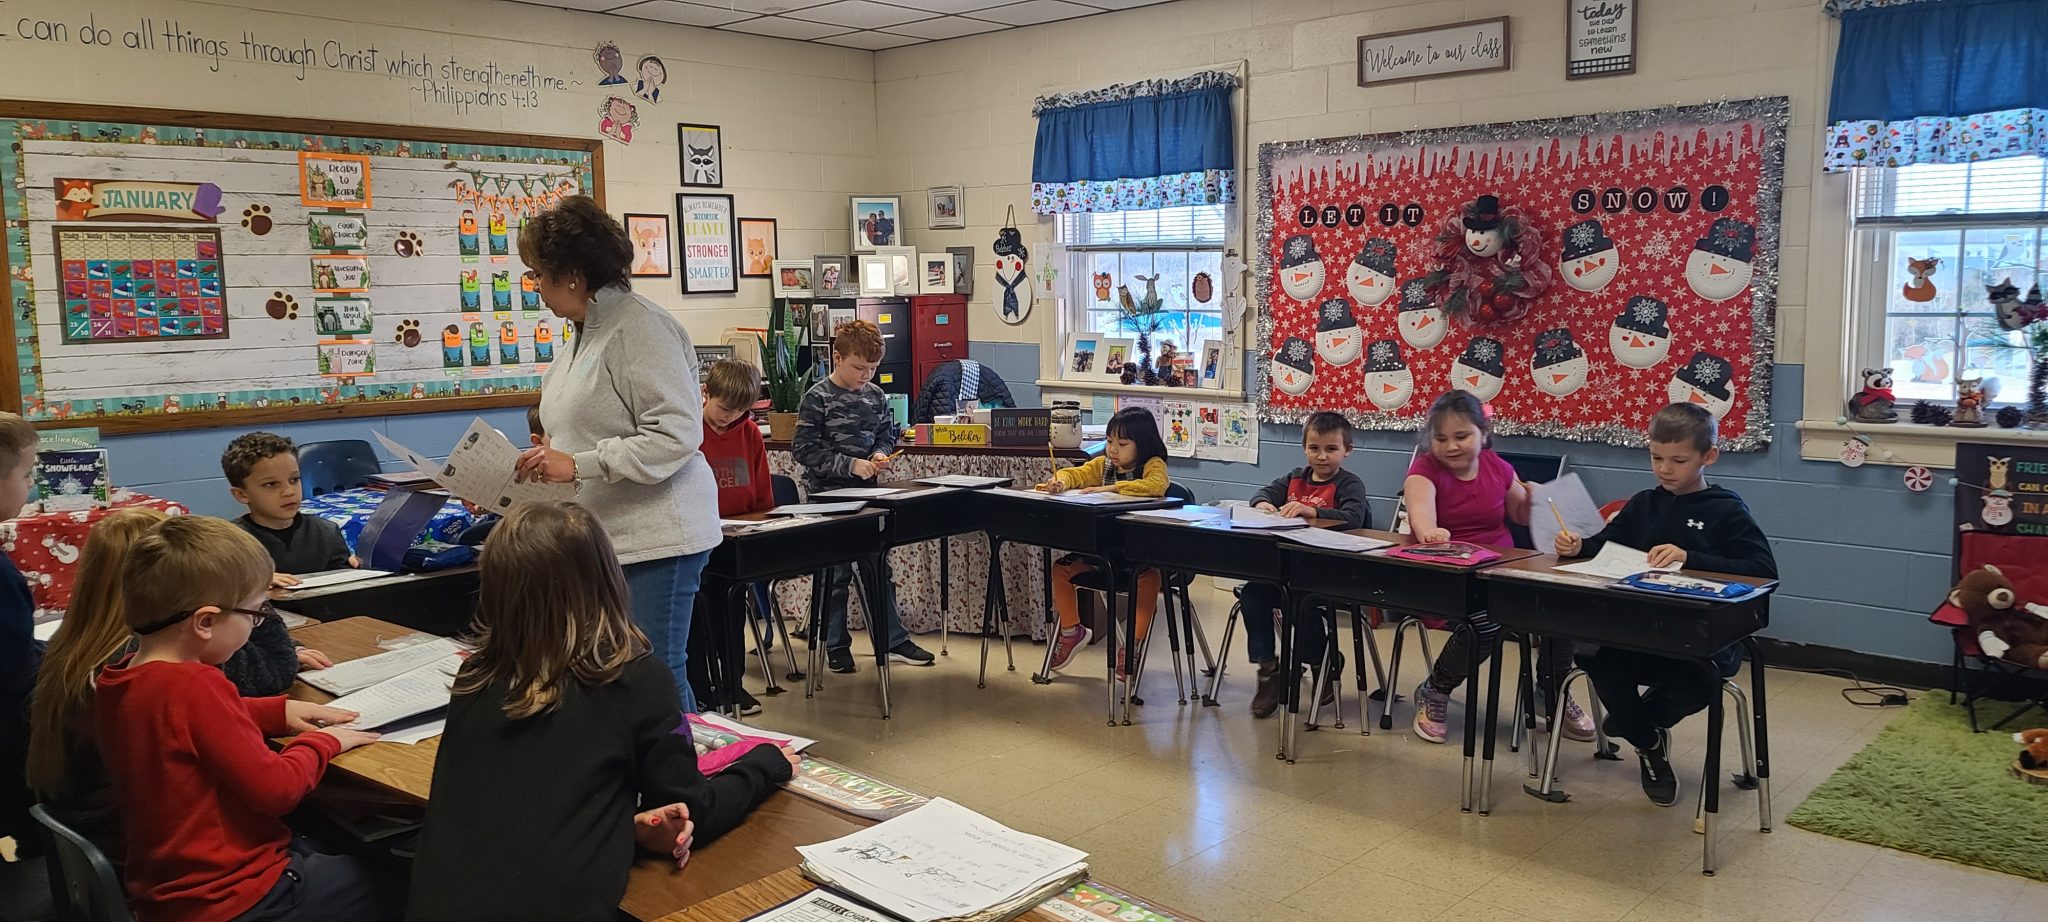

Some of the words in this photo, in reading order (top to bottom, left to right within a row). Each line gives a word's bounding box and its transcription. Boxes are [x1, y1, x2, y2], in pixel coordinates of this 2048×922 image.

[1577, 2, 1627, 20] today
[17, 18, 68, 42] can
[79, 12, 112, 46] do
[123, 18, 154, 49] all
[161, 19, 230, 72] things
[240, 31, 317, 80] through
[323, 40, 378, 72] Christ
[385, 50, 433, 79] which
[441, 58, 540, 88] strengtheneth
[1365, 45, 1423, 73] Welcome
[1427, 43, 1440, 64] to
[1445, 44, 1466, 62] our
[1471, 32, 1501, 58] class
[1591, 46, 1612, 54] new
[512, 90, 539, 108] 4:13
[340, 176, 349, 184] to
[102, 189, 193, 211] JANUARY
[702, 201, 728, 214] REMEMBER
[1303, 207, 1361, 225] LET
[1386, 207, 1419, 223] IT
[687, 244, 729, 258] STRONGER
[688, 266, 730, 279] SMARTER
[948, 430, 981, 442] Belcher
[45, 464, 95, 472] SNOWFLAKE
[2018, 483, 2040, 491] CAN
[2023, 502, 2039, 513] IN
